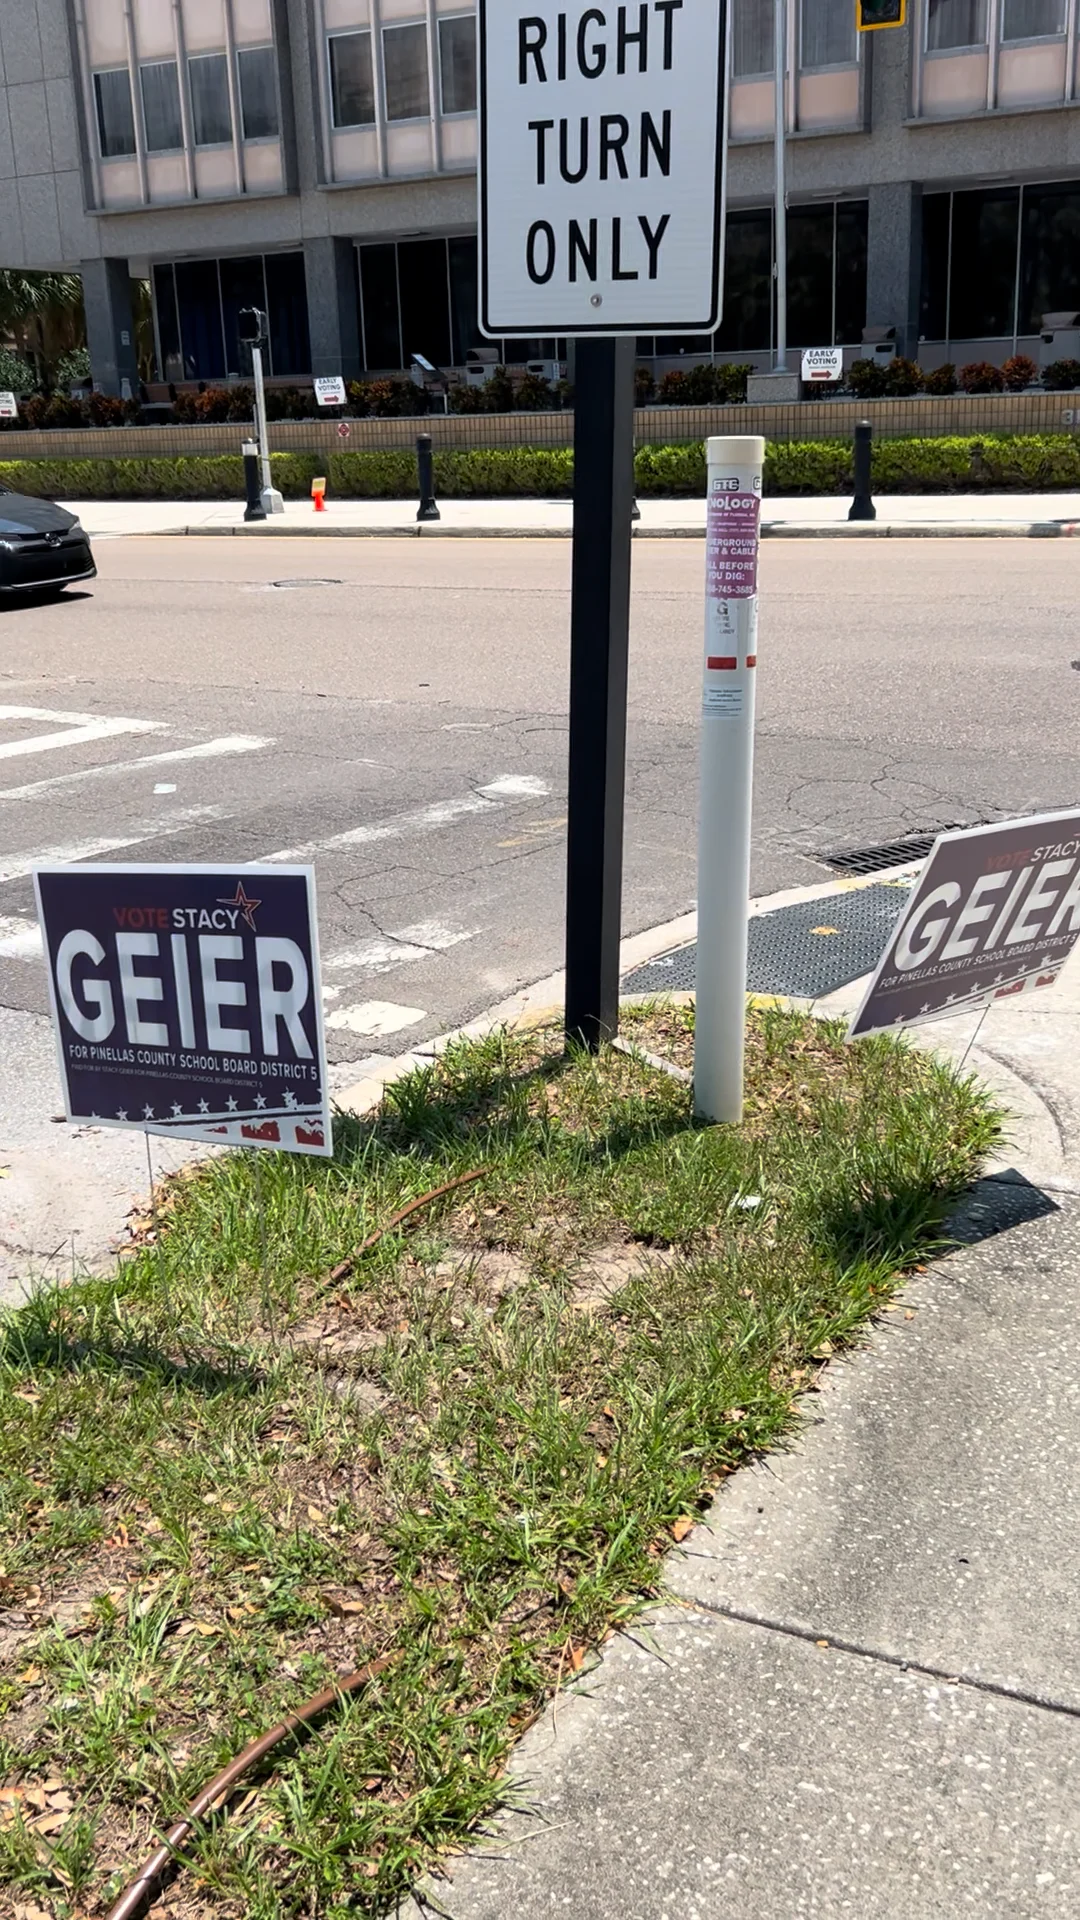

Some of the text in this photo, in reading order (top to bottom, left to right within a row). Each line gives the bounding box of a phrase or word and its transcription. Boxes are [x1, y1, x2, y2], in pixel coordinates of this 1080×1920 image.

[518, 0, 683, 84] RIGHT
[528, 109, 671, 185] TURN
[526, 214, 671, 285] ONLY
[806, 357, 838, 365] VOTING
[713, 479, 738, 490] GTE
[719, 562, 754, 570] BEFORE
[730, 547, 756, 556] CABLE
[725, 572, 745, 581] DIG:
[986, 840, 1080, 871] VOTE STACY
[113, 908, 239, 930] VOTE STACY
[879, 977, 897, 988] FOR
[898, 966, 937, 982] PINELLAS
[938, 957, 972, 974] COUNTY
[973, 950, 1005, 966] SCHOOL
[1007, 942, 1034, 957] BOARD
[1035, 936, 1070, 952] DISTRICT
[56, 929, 315, 1060] GEIER
[69, 1045, 318, 1080] FOR PINELLAS COUNTY SCHOOL BOARD DISTRICT 5
